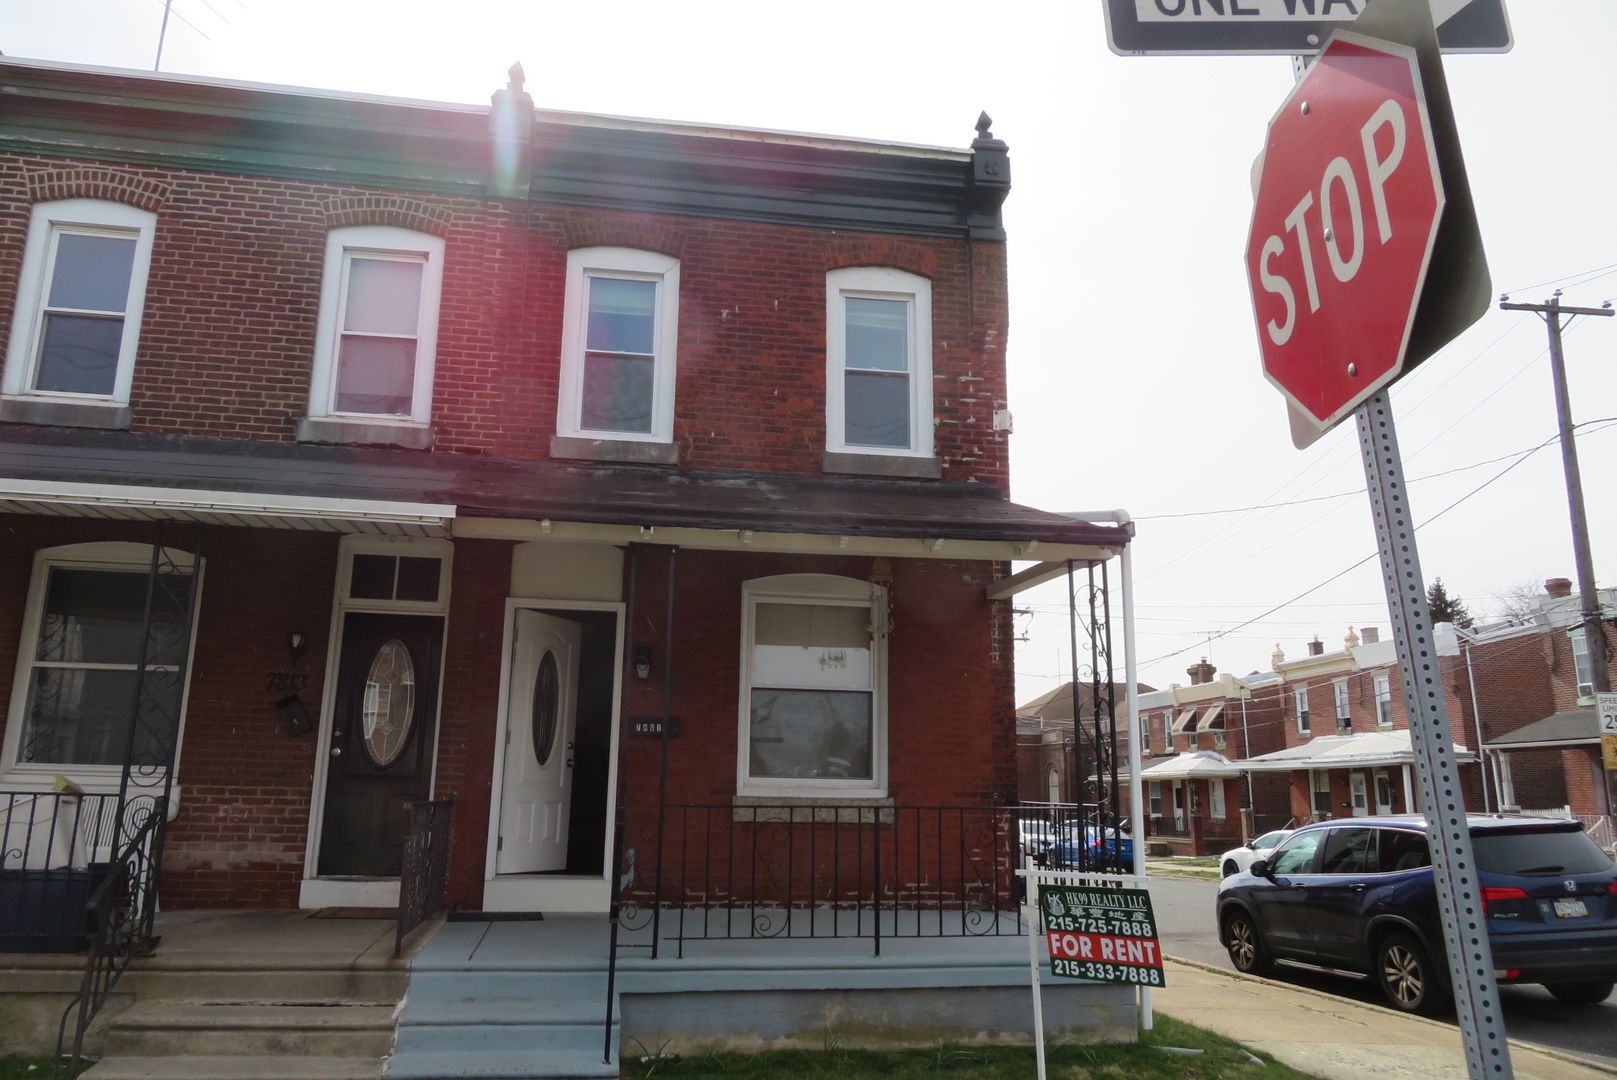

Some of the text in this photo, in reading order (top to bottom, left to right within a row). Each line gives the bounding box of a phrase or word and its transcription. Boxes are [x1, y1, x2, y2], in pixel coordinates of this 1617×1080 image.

[1259, 98, 1407, 347] STOP
[1065, 892, 1147, 909] HK99 REALTY LLC
[1048, 916, 1152, 937] 215-725-7888
[1050, 933, 1155, 964] FOR RENT
[1054, 959, 1160, 985] 215-333-7888
